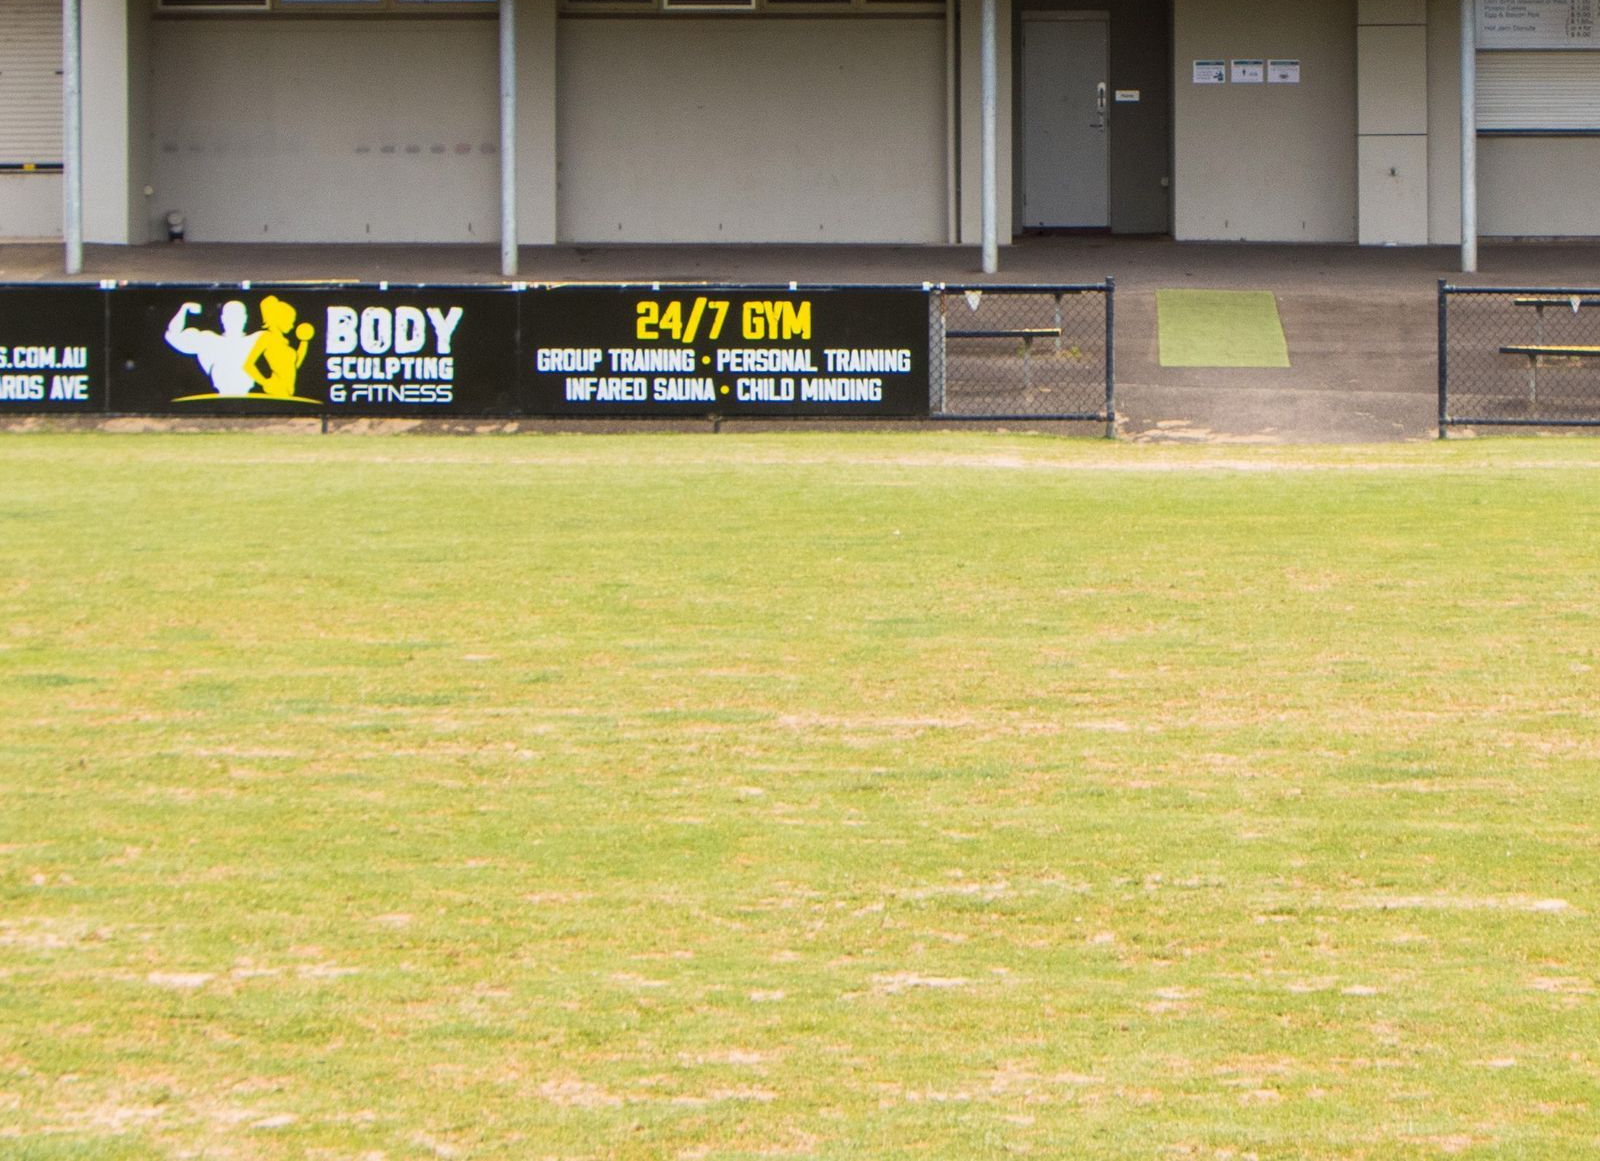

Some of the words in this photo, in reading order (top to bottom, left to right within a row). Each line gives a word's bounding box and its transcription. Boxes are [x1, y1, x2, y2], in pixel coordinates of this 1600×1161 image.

[326, 305, 464, 355] BODY
[636, 296, 730, 343] 24/7
[742, 300, 811, 340] GYM
[0, 345, 87, 369] S.COM.AU
[326, 356, 454, 380] SCULPTING
[536, 347, 602, 372] GROUP
[607, 347, 695, 372] TRAINING
[716, 347, 818, 373] PERSONAL
[823, 347, 912, 373] TRAINING
[0, 374, 45, 400] RDS
[49, 374, 89, 400] AVE
[329, 383, 347, 403] &
[351, 383, 453, 403] FITNESS
[565, 377, 648, 401] INFARED
[653, 377, 716, 401] SAUNA
[736, 377, 795, 401] CHILD
[800, 377, 883, 401] MINDING
